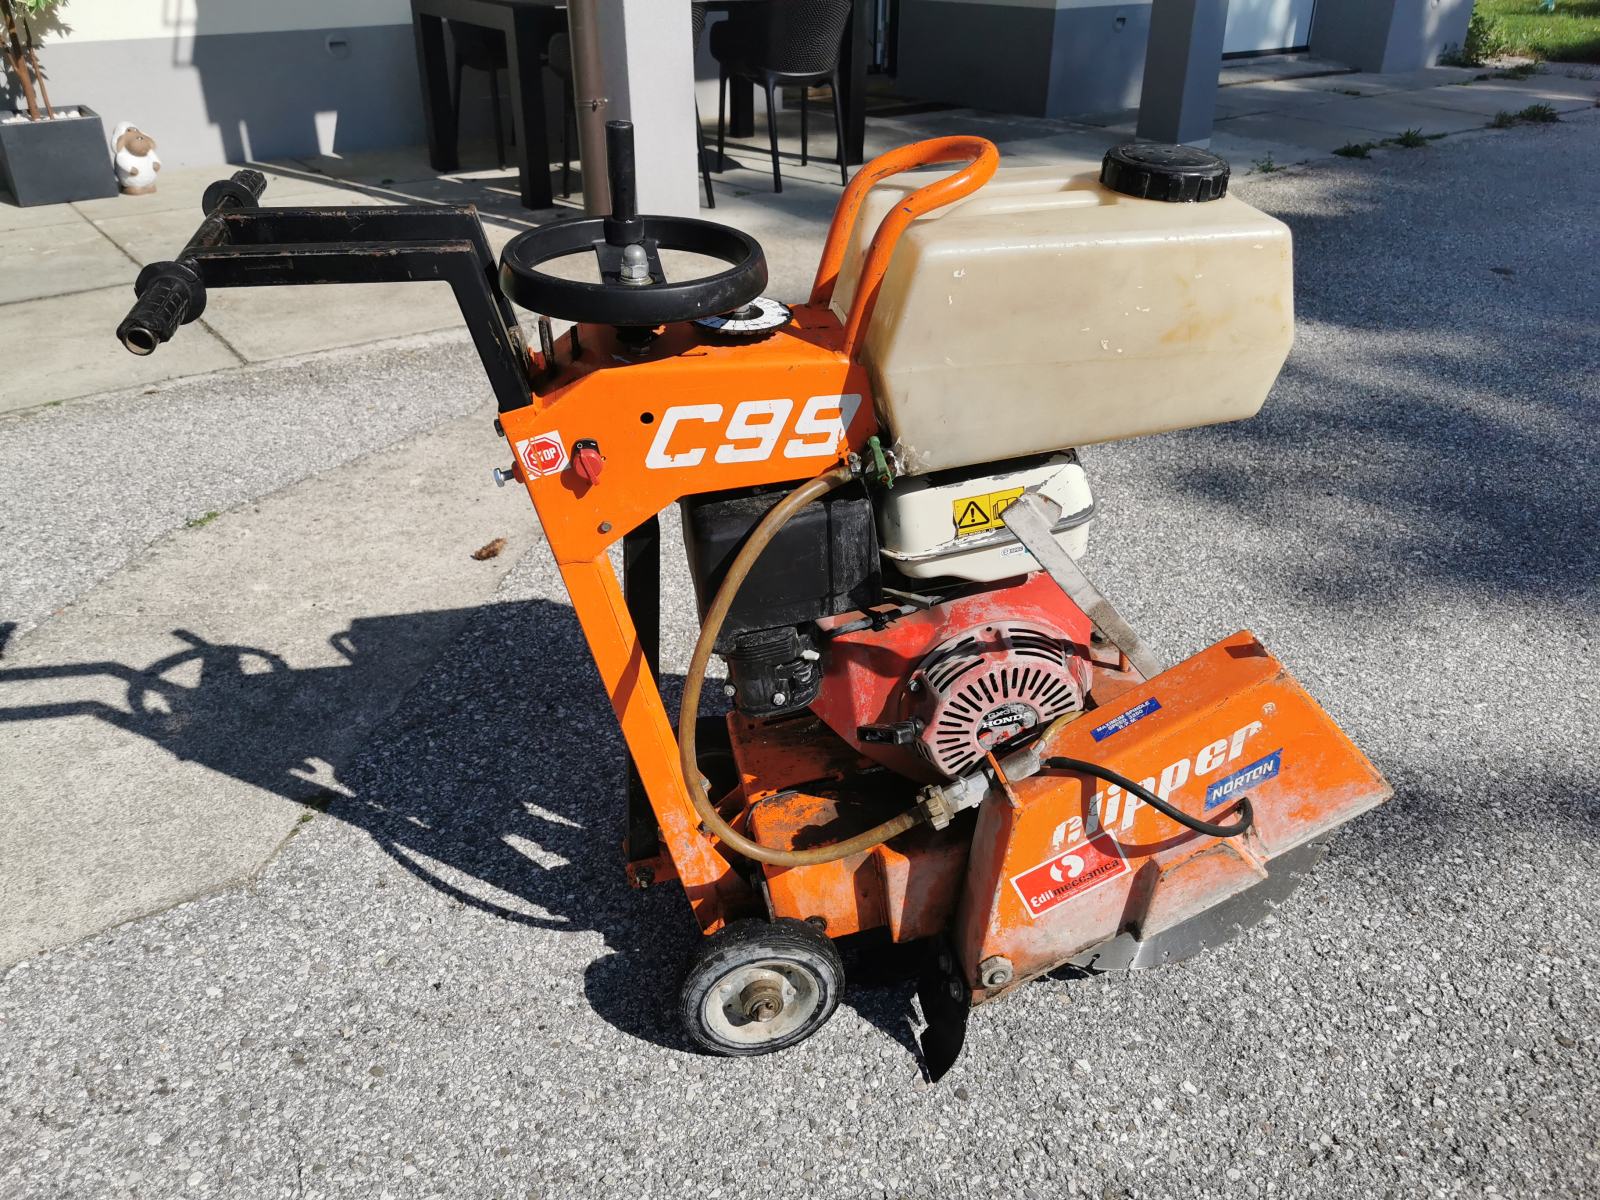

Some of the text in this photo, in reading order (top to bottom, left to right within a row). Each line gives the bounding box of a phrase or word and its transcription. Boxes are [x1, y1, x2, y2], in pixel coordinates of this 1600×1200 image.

[645, 393, 862, 469] C99
[530, 446, 557, 464] STOP
[1211, 758, 1275, 801] NORTON
[1030, 858, 1120, 908] Edilmeccanica
